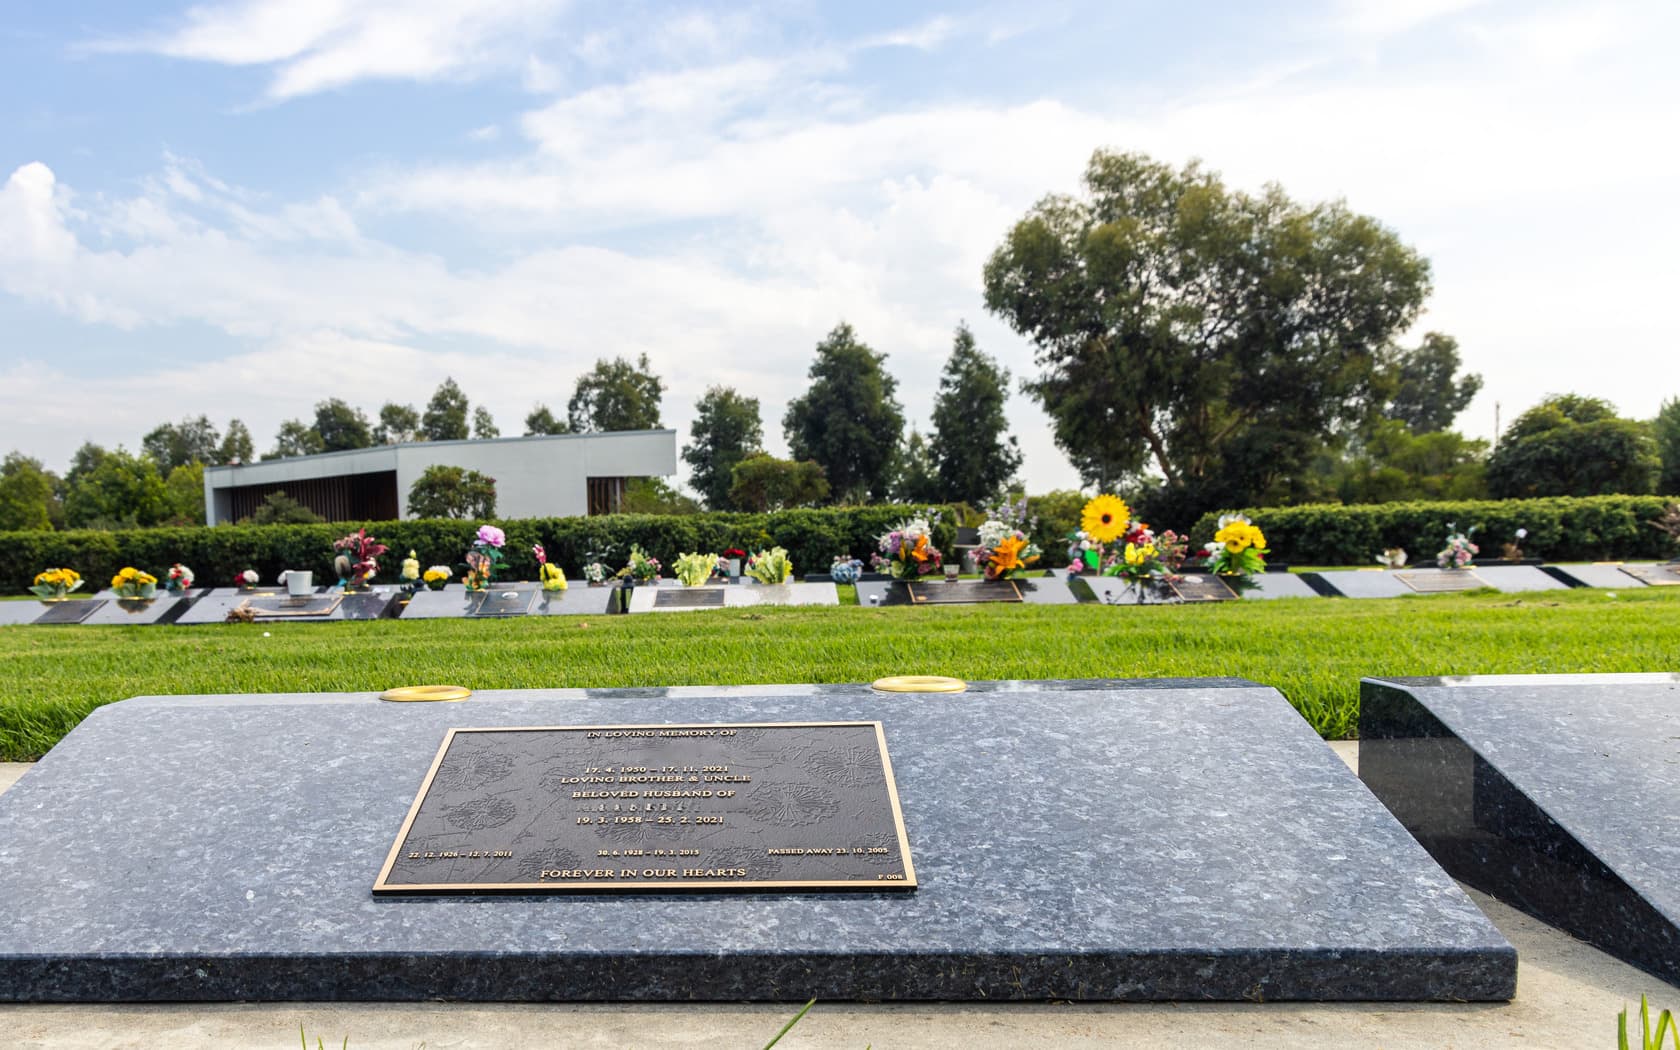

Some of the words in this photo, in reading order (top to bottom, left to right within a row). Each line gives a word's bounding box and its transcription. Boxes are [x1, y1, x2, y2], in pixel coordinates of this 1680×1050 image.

[540, 869, 615, 878] FOREVER
[620, 869, 638, 878] IN
[642, 869, 678, 878] OUR
[682, 868, 746, 877] HEARTS
